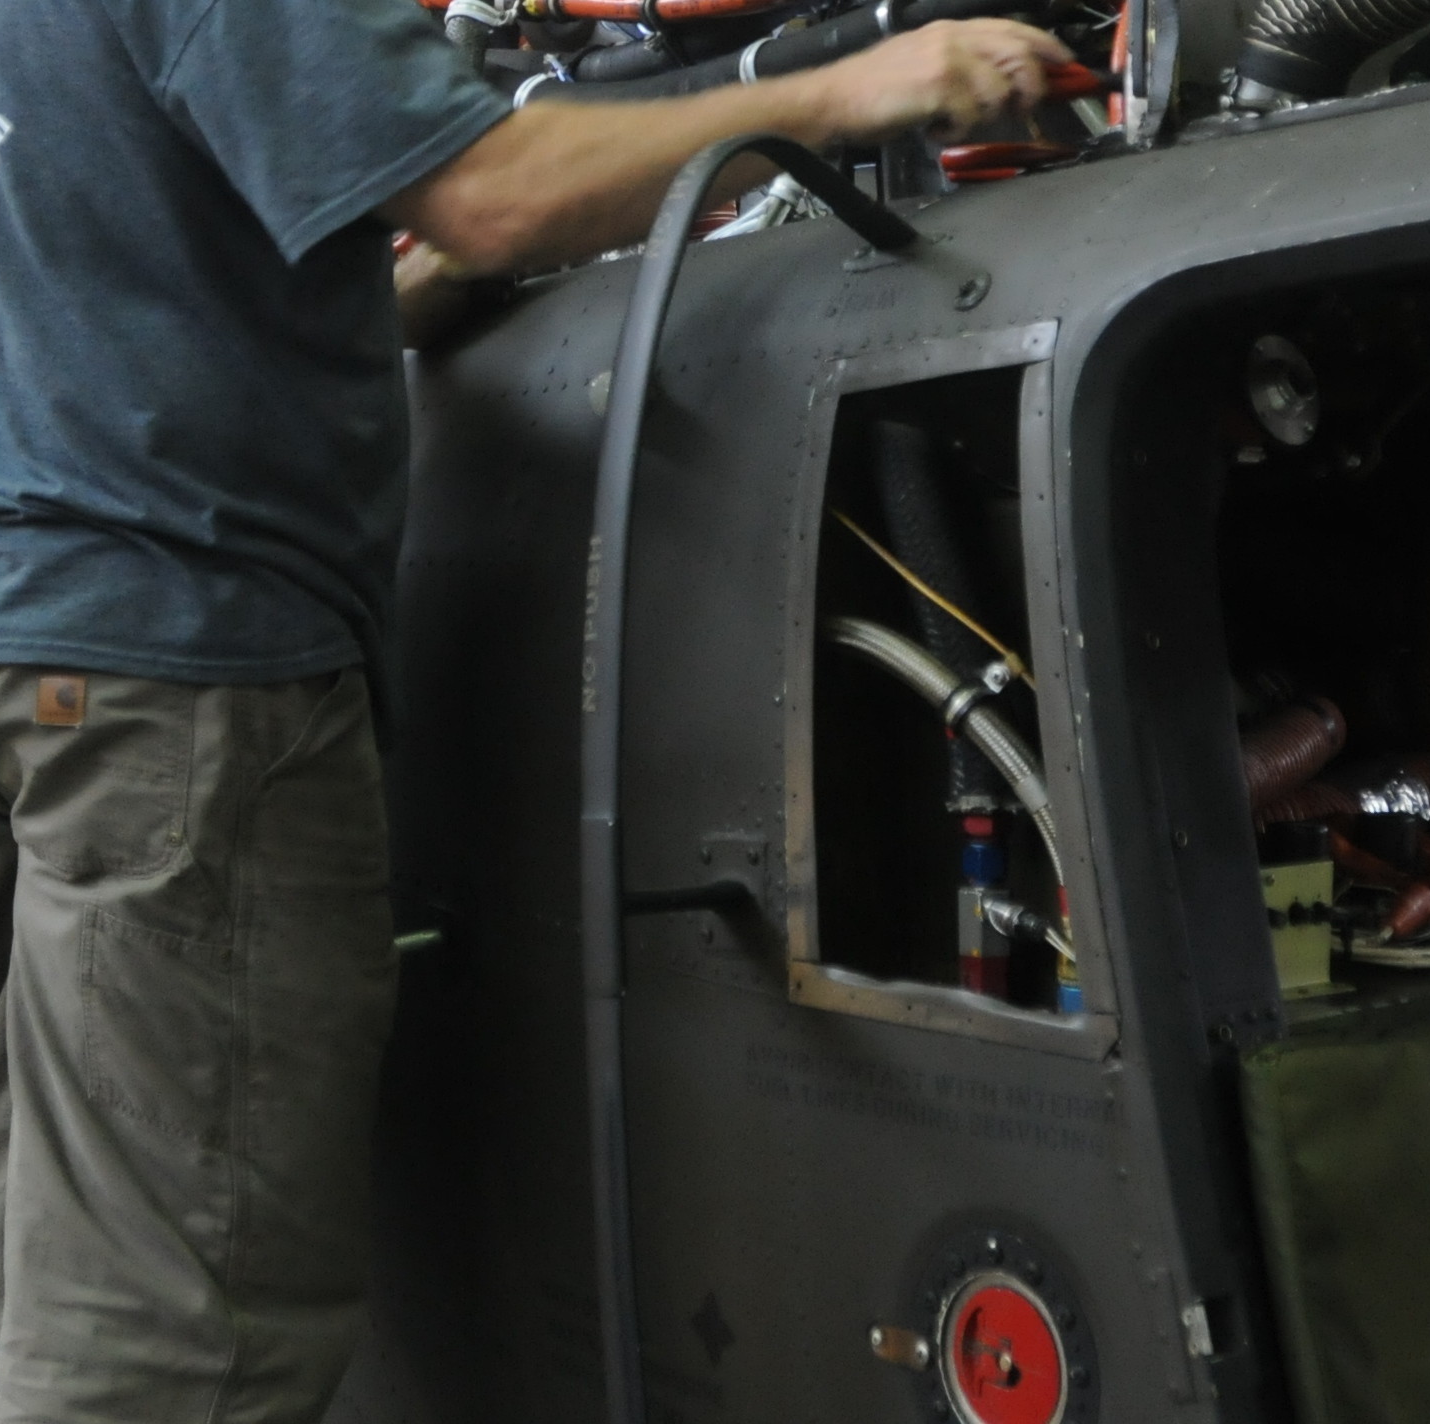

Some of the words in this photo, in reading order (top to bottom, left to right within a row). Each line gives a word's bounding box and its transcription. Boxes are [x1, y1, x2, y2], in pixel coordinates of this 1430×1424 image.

[582, 656, 597, 713] NO
[933, 1070, 998, 1109] WITH
[966, 1108, 1108, 1161] SERVICING
